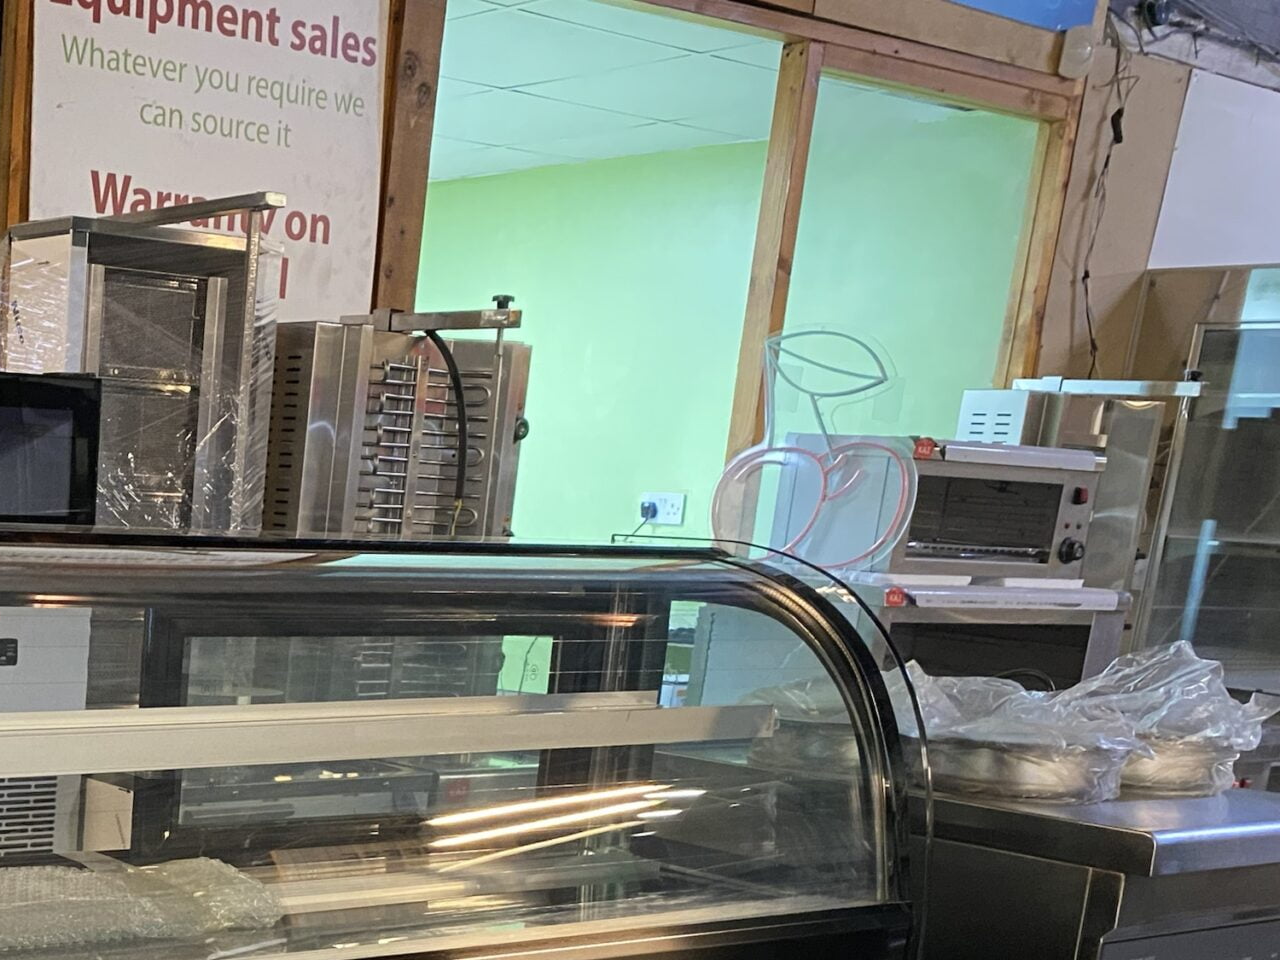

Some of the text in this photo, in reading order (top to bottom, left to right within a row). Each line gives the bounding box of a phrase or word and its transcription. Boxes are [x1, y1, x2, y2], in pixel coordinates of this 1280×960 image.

[289, 16, 377, 67] sales
[61, 33, 365, 117] Whatever you require we
[139, 102, 292, 148] can source it
[285, 210, 330, 245] on
